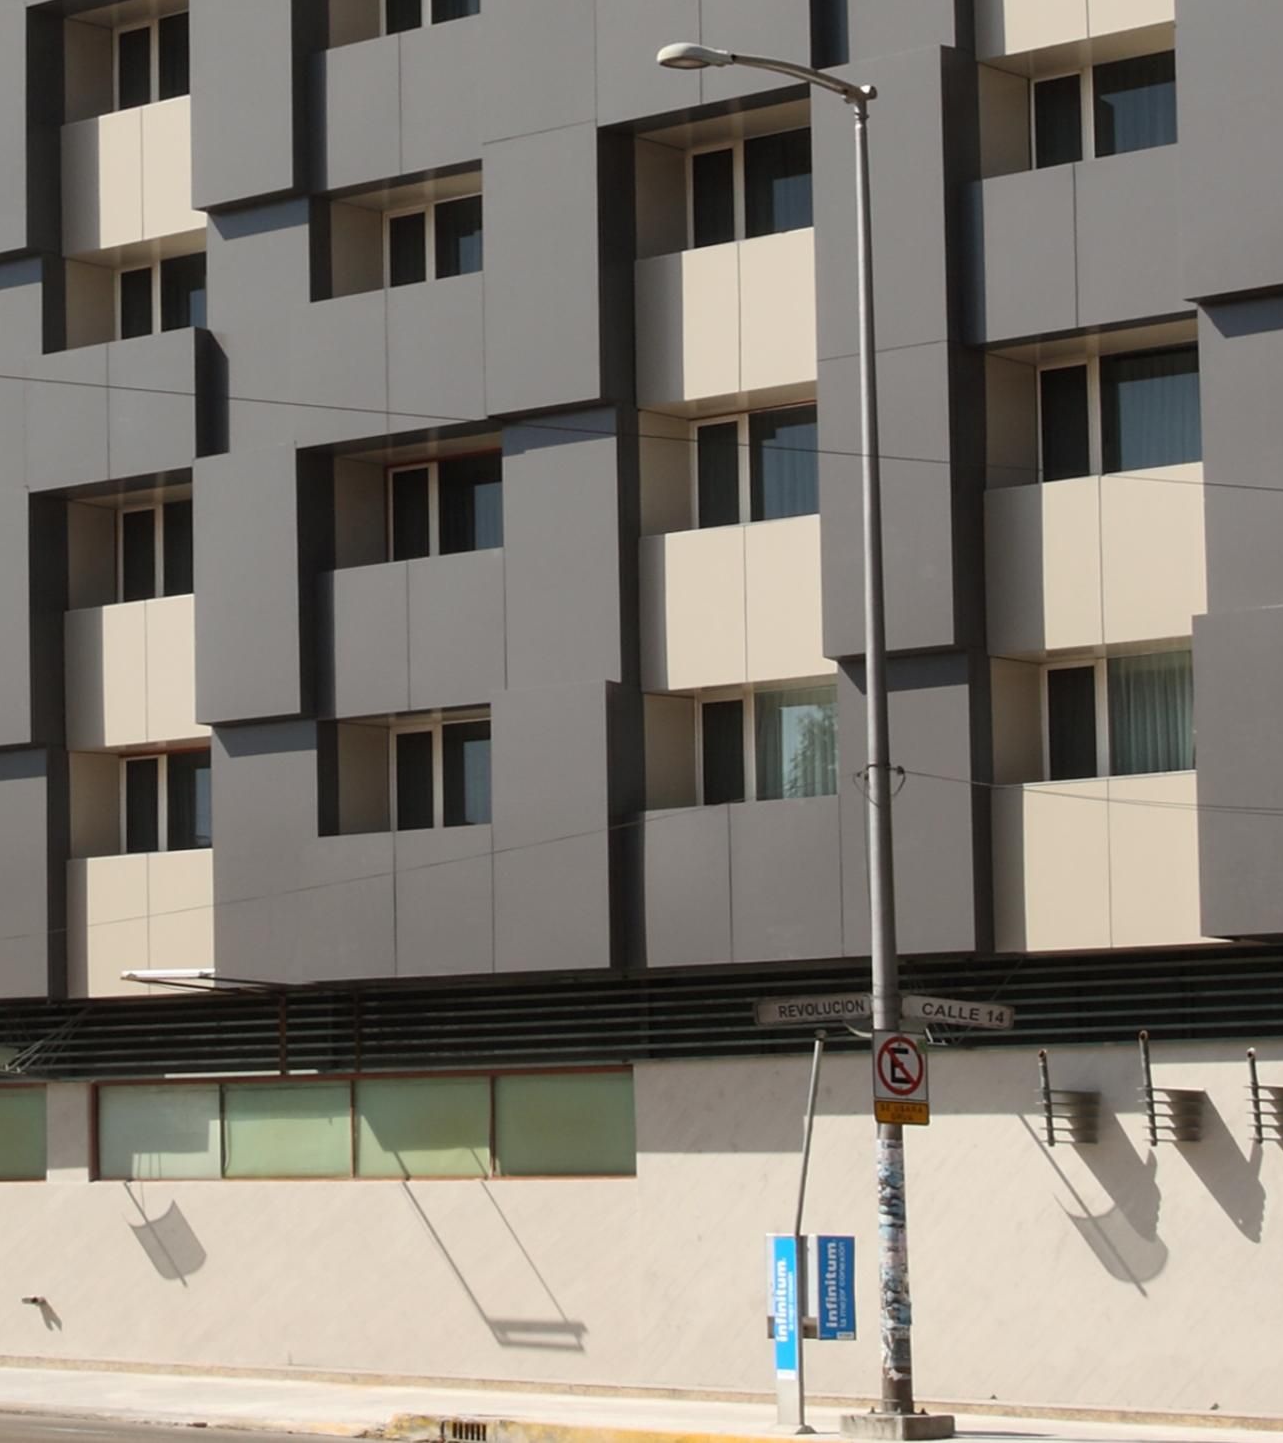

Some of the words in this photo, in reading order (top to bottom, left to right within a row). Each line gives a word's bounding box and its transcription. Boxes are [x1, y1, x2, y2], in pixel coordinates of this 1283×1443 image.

[778, 999, 865, 1019] REVOLUCION
[921, 1002, 980, 1021] CALLE
[986, 1010, 1005, 1024] 14
[775, 1260, 788, 1342] infinitum
[824, 1242, 838, 1328] infinitum
